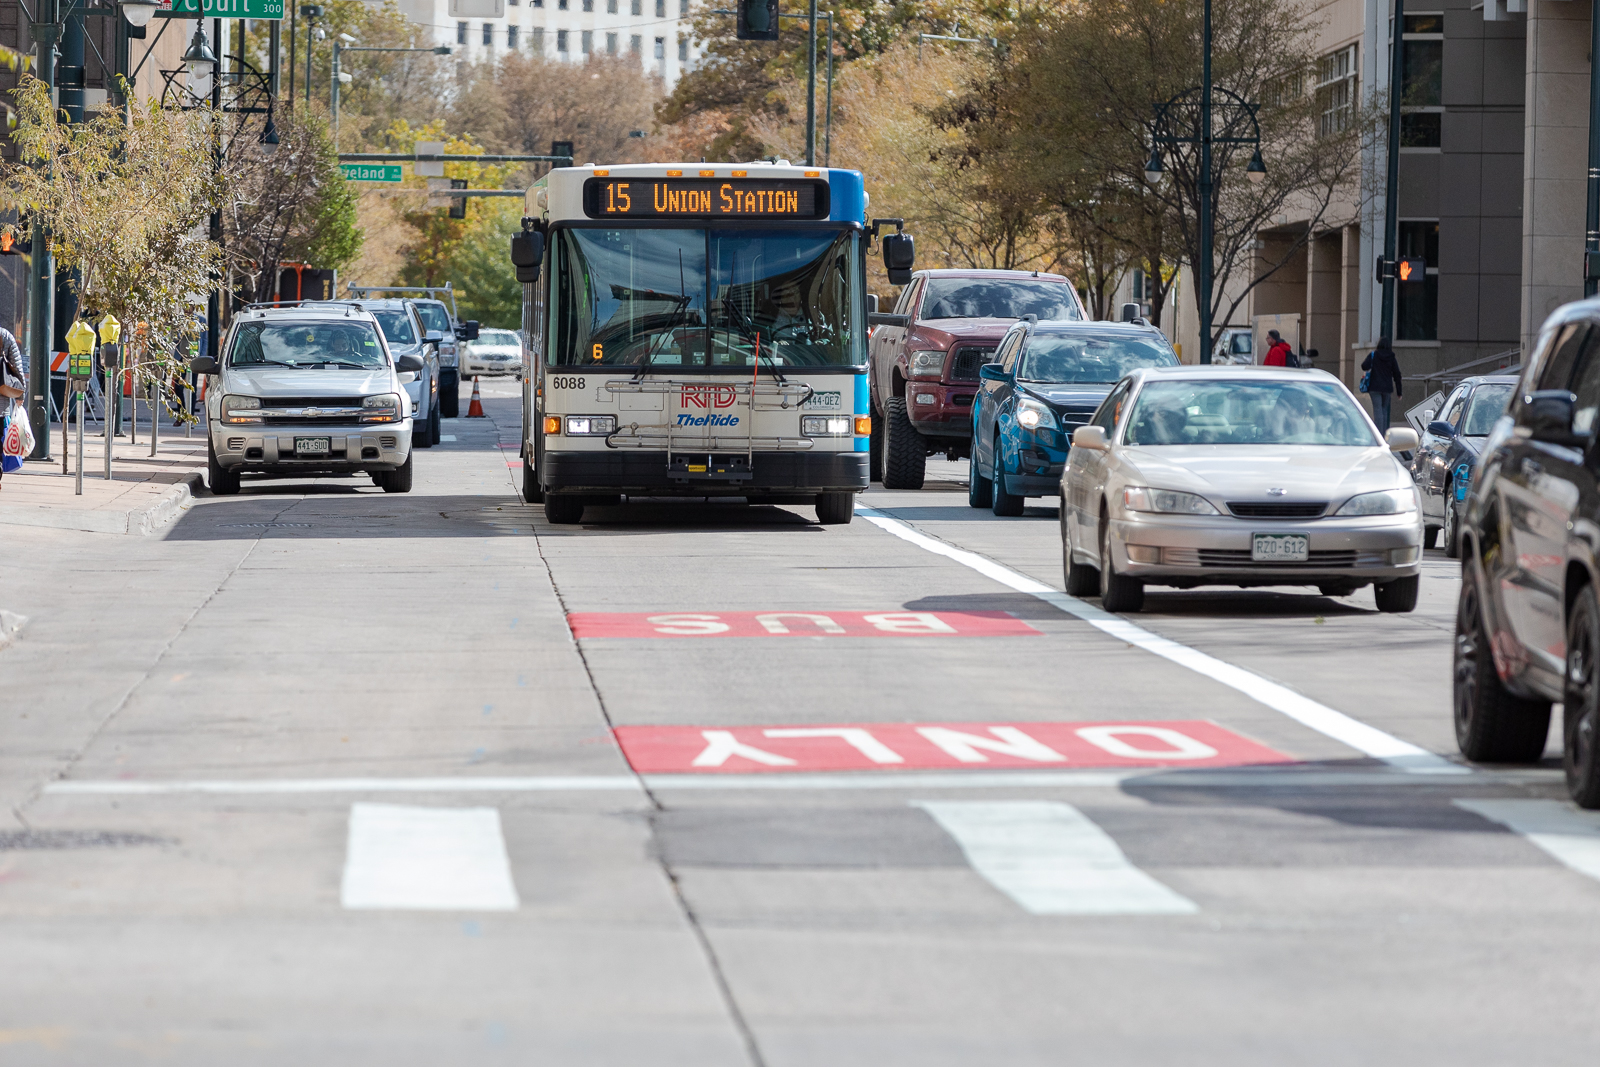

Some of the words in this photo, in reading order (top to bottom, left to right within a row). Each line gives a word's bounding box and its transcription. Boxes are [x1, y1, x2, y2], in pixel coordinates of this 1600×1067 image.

[263, 4, 282, 13] 300
[341, 167, 386, 180] veland
[606, 183, 631, 212] 15
[592, 343, 603, 360] 6
[553, 376, 586, 390] 6088
[676, 413, 740, 427] TheRide
[646, 612, 959, 635] BUS
[691, 725, 1219, 767] ONLY
